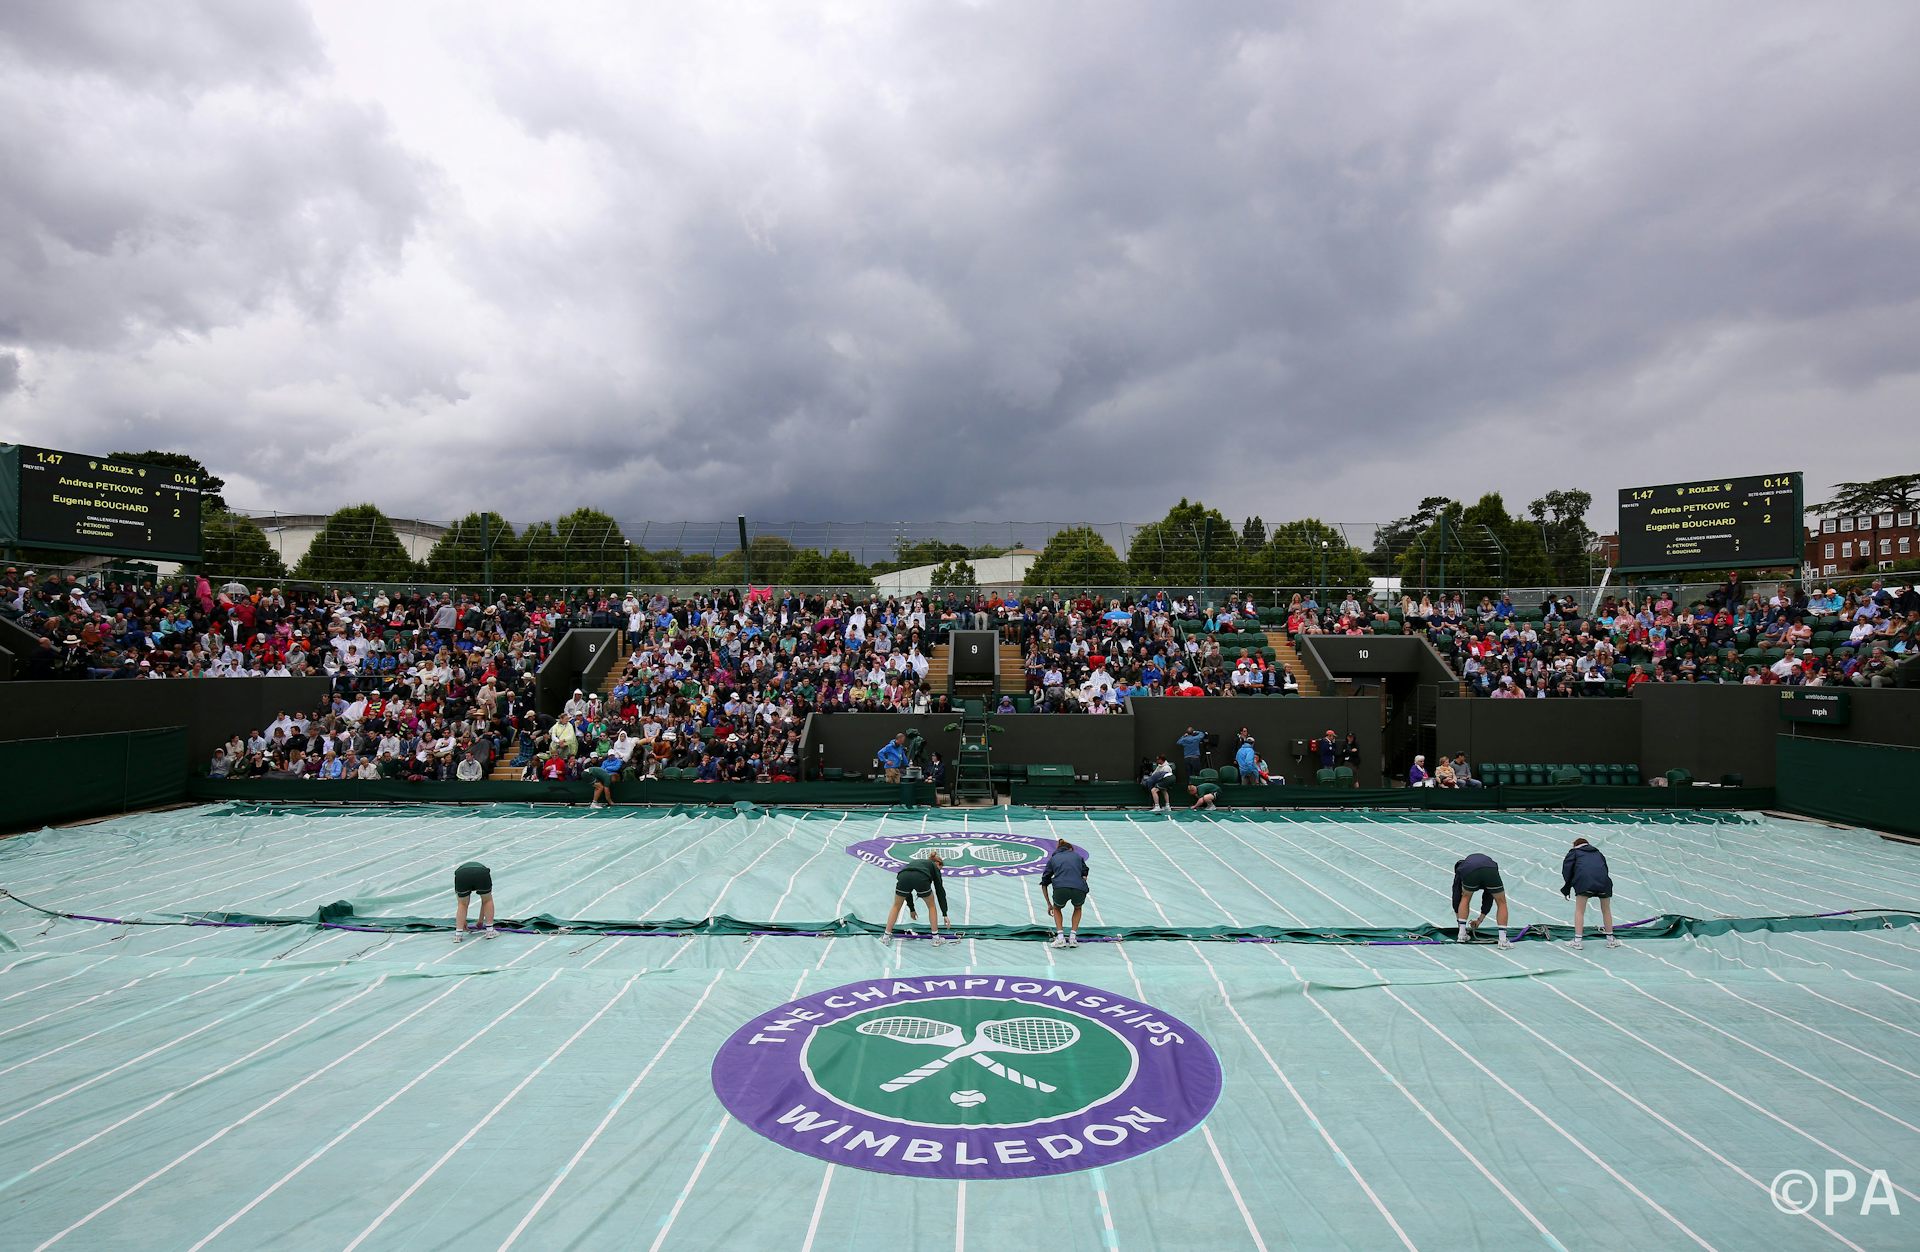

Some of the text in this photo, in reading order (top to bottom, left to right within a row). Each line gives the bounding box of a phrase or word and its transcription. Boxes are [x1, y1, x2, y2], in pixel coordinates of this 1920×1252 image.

[37, 452, 63, 464] 1.47
[102, 464, 134, 475] ROLEX
[174, 473, 197, 485] 0.14
[1763, 476, 1790, 488] 0.14
[59, 477, 144, 495] Andrea PETKOVIC
[1688, 485, 1720, 494] ROLEX
[174, 492, 180, 500] 1
[1632, 490, 1654, 500] 1.47
[53, 494, 149, 513] Eugenie BOUCHARD
[1764, 497, 1770, 506] 1
[173, 509, 180, 518] 2
[1651, 502, 1730, 515] Andrea PETKOVIC
[1763, 514, 1771, 523] 2
[1646, 518, 1736, 532] Eugenie BOUCHARD
[82, 529, 114, 537] BOUCHARD
[971, 644, 978, 654] 9
[1359, 649, 1369, 659] 10
[1781, 691, 1794, 699] IBM
[1812, 708, 1827, 716] mph
[749, 977, 1185, 1048] THE CHAMPIONSHIPS
[776, 1104, 1168, 1166] WIMBLEDON
